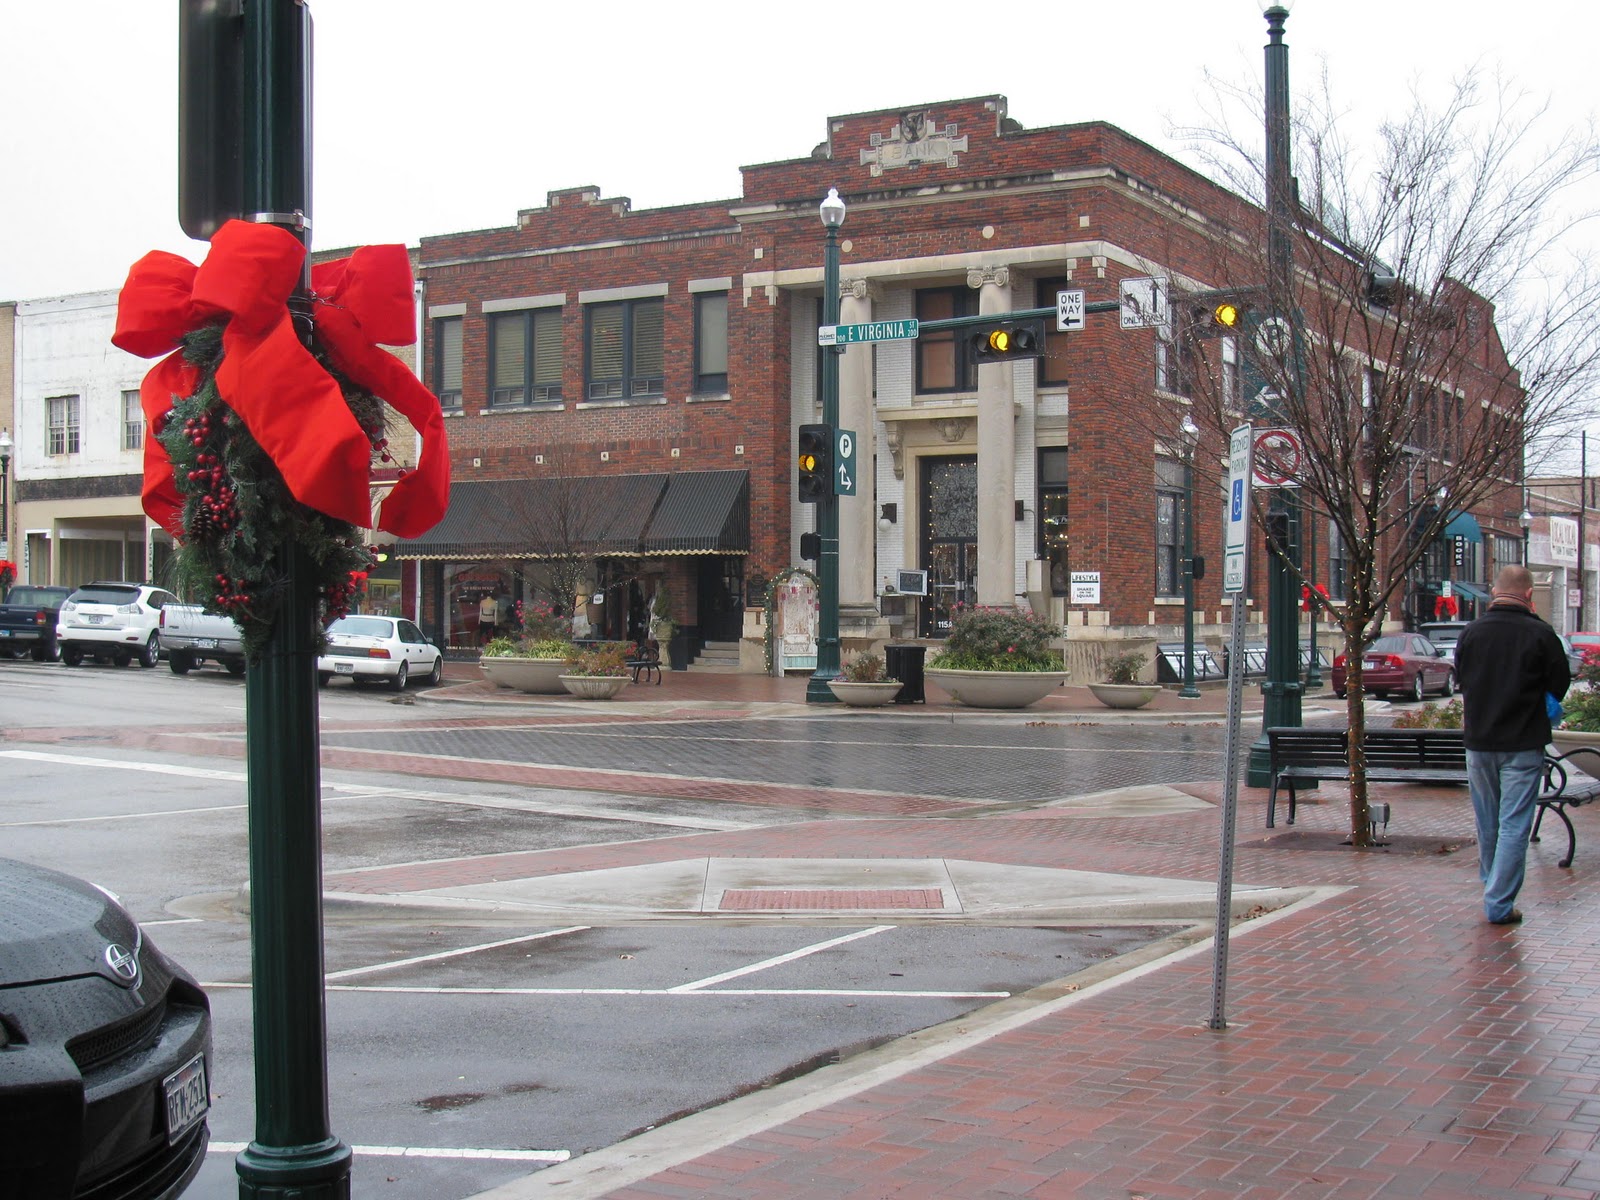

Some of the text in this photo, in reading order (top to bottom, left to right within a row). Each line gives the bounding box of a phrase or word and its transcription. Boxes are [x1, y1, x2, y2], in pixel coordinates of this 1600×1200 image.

[891, 140, 938, 160] BANK
[1060, 293, 1081, 304] ONE
[1060, 304, 1081, 315] WAY
[848, 326, 854, 342] E
[857, 322, 905, 341] VIRGINIA
[909, 321, 915, 329] ST
[907, 329, 917, 337] 200
[1455, 535, 1463, 566] BOOKS
